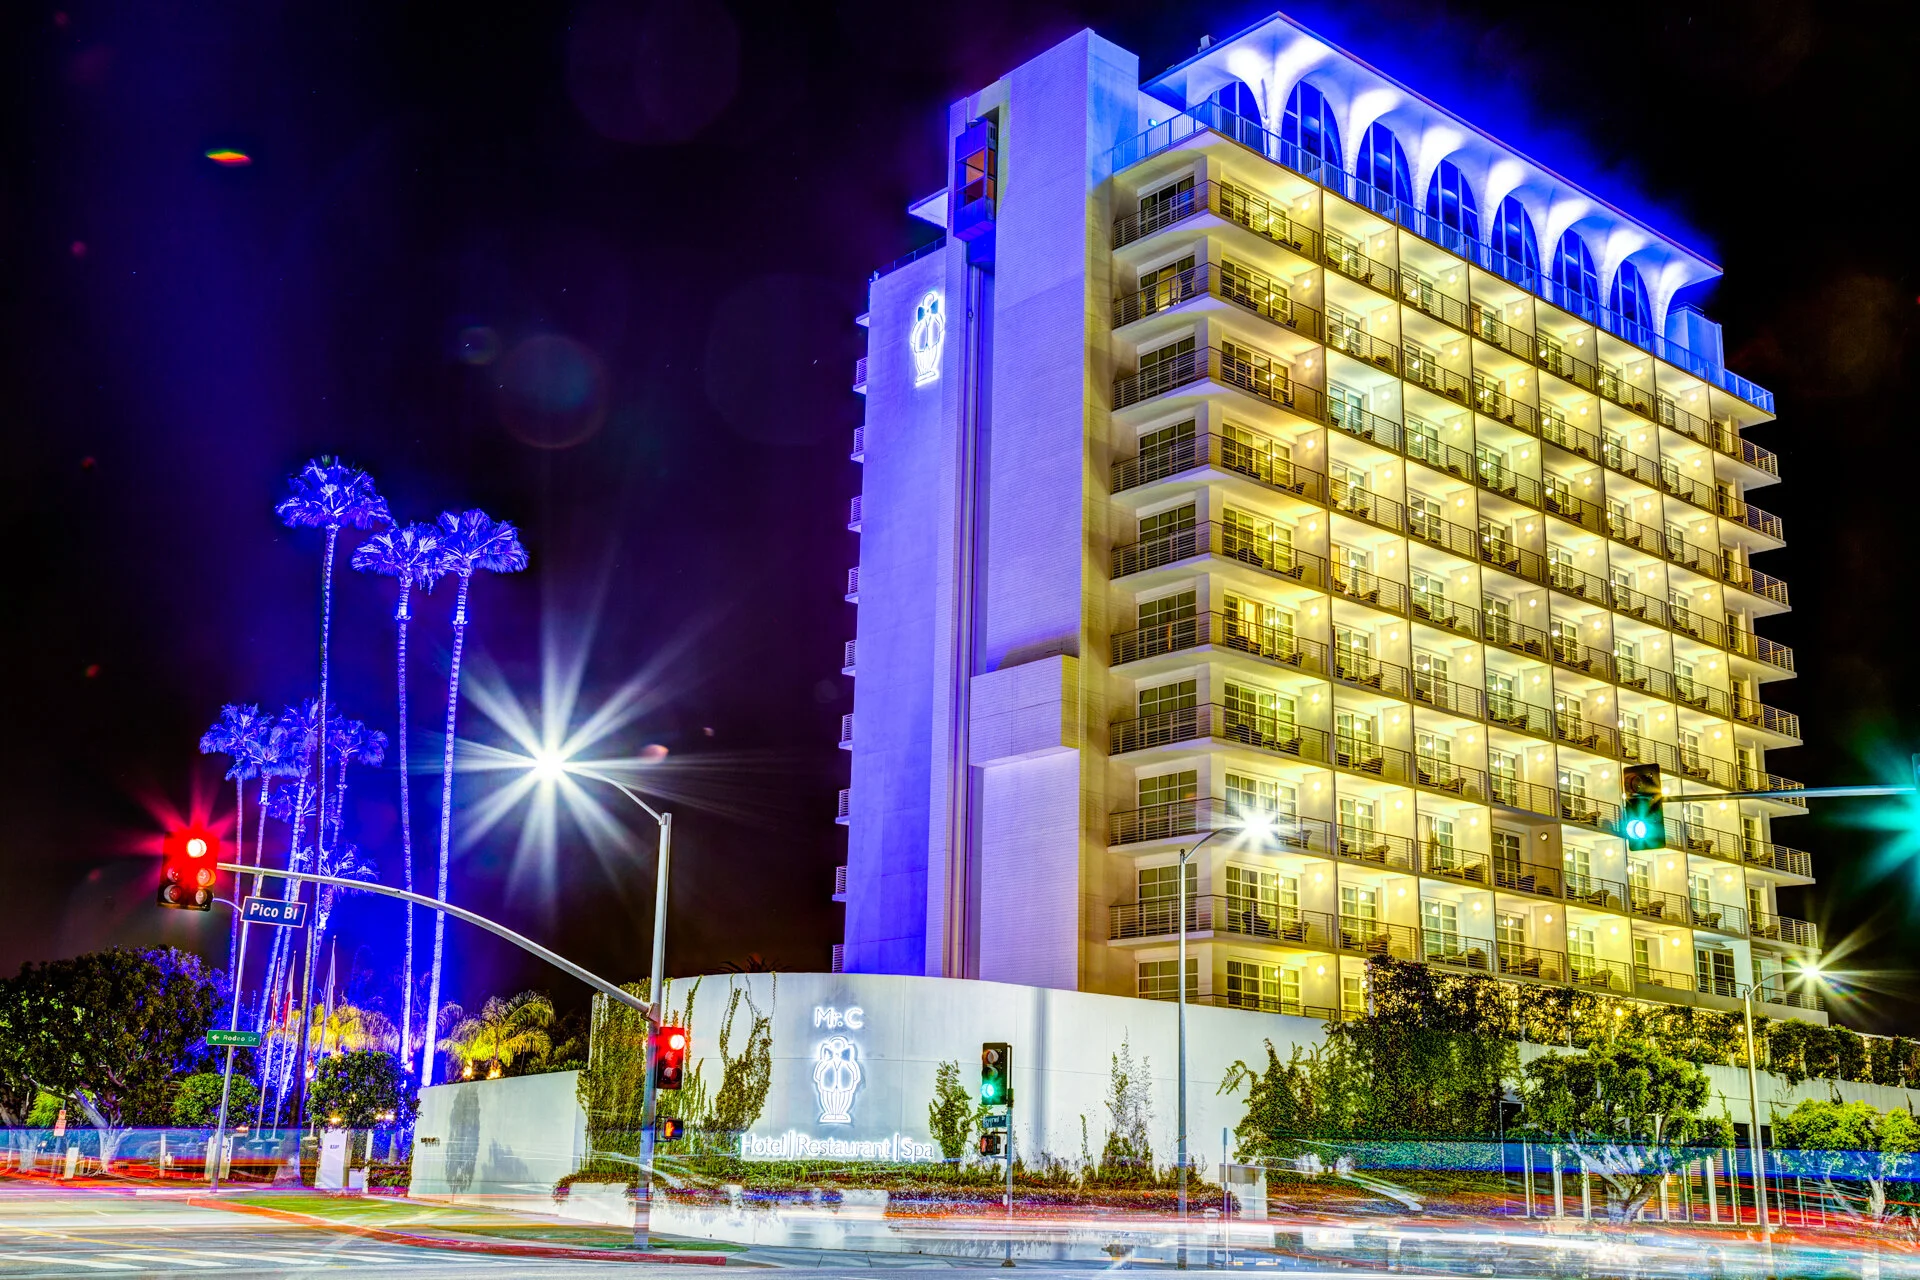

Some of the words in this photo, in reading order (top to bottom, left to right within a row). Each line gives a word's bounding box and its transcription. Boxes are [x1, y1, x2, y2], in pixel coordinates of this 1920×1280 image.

[250, 903, 279, 917] Pico
[740, 1133, 785, 1156] Hotel
[796, 1134, 890, 1158] Restaurant
[902, 1137, 934, 1162] Spa
